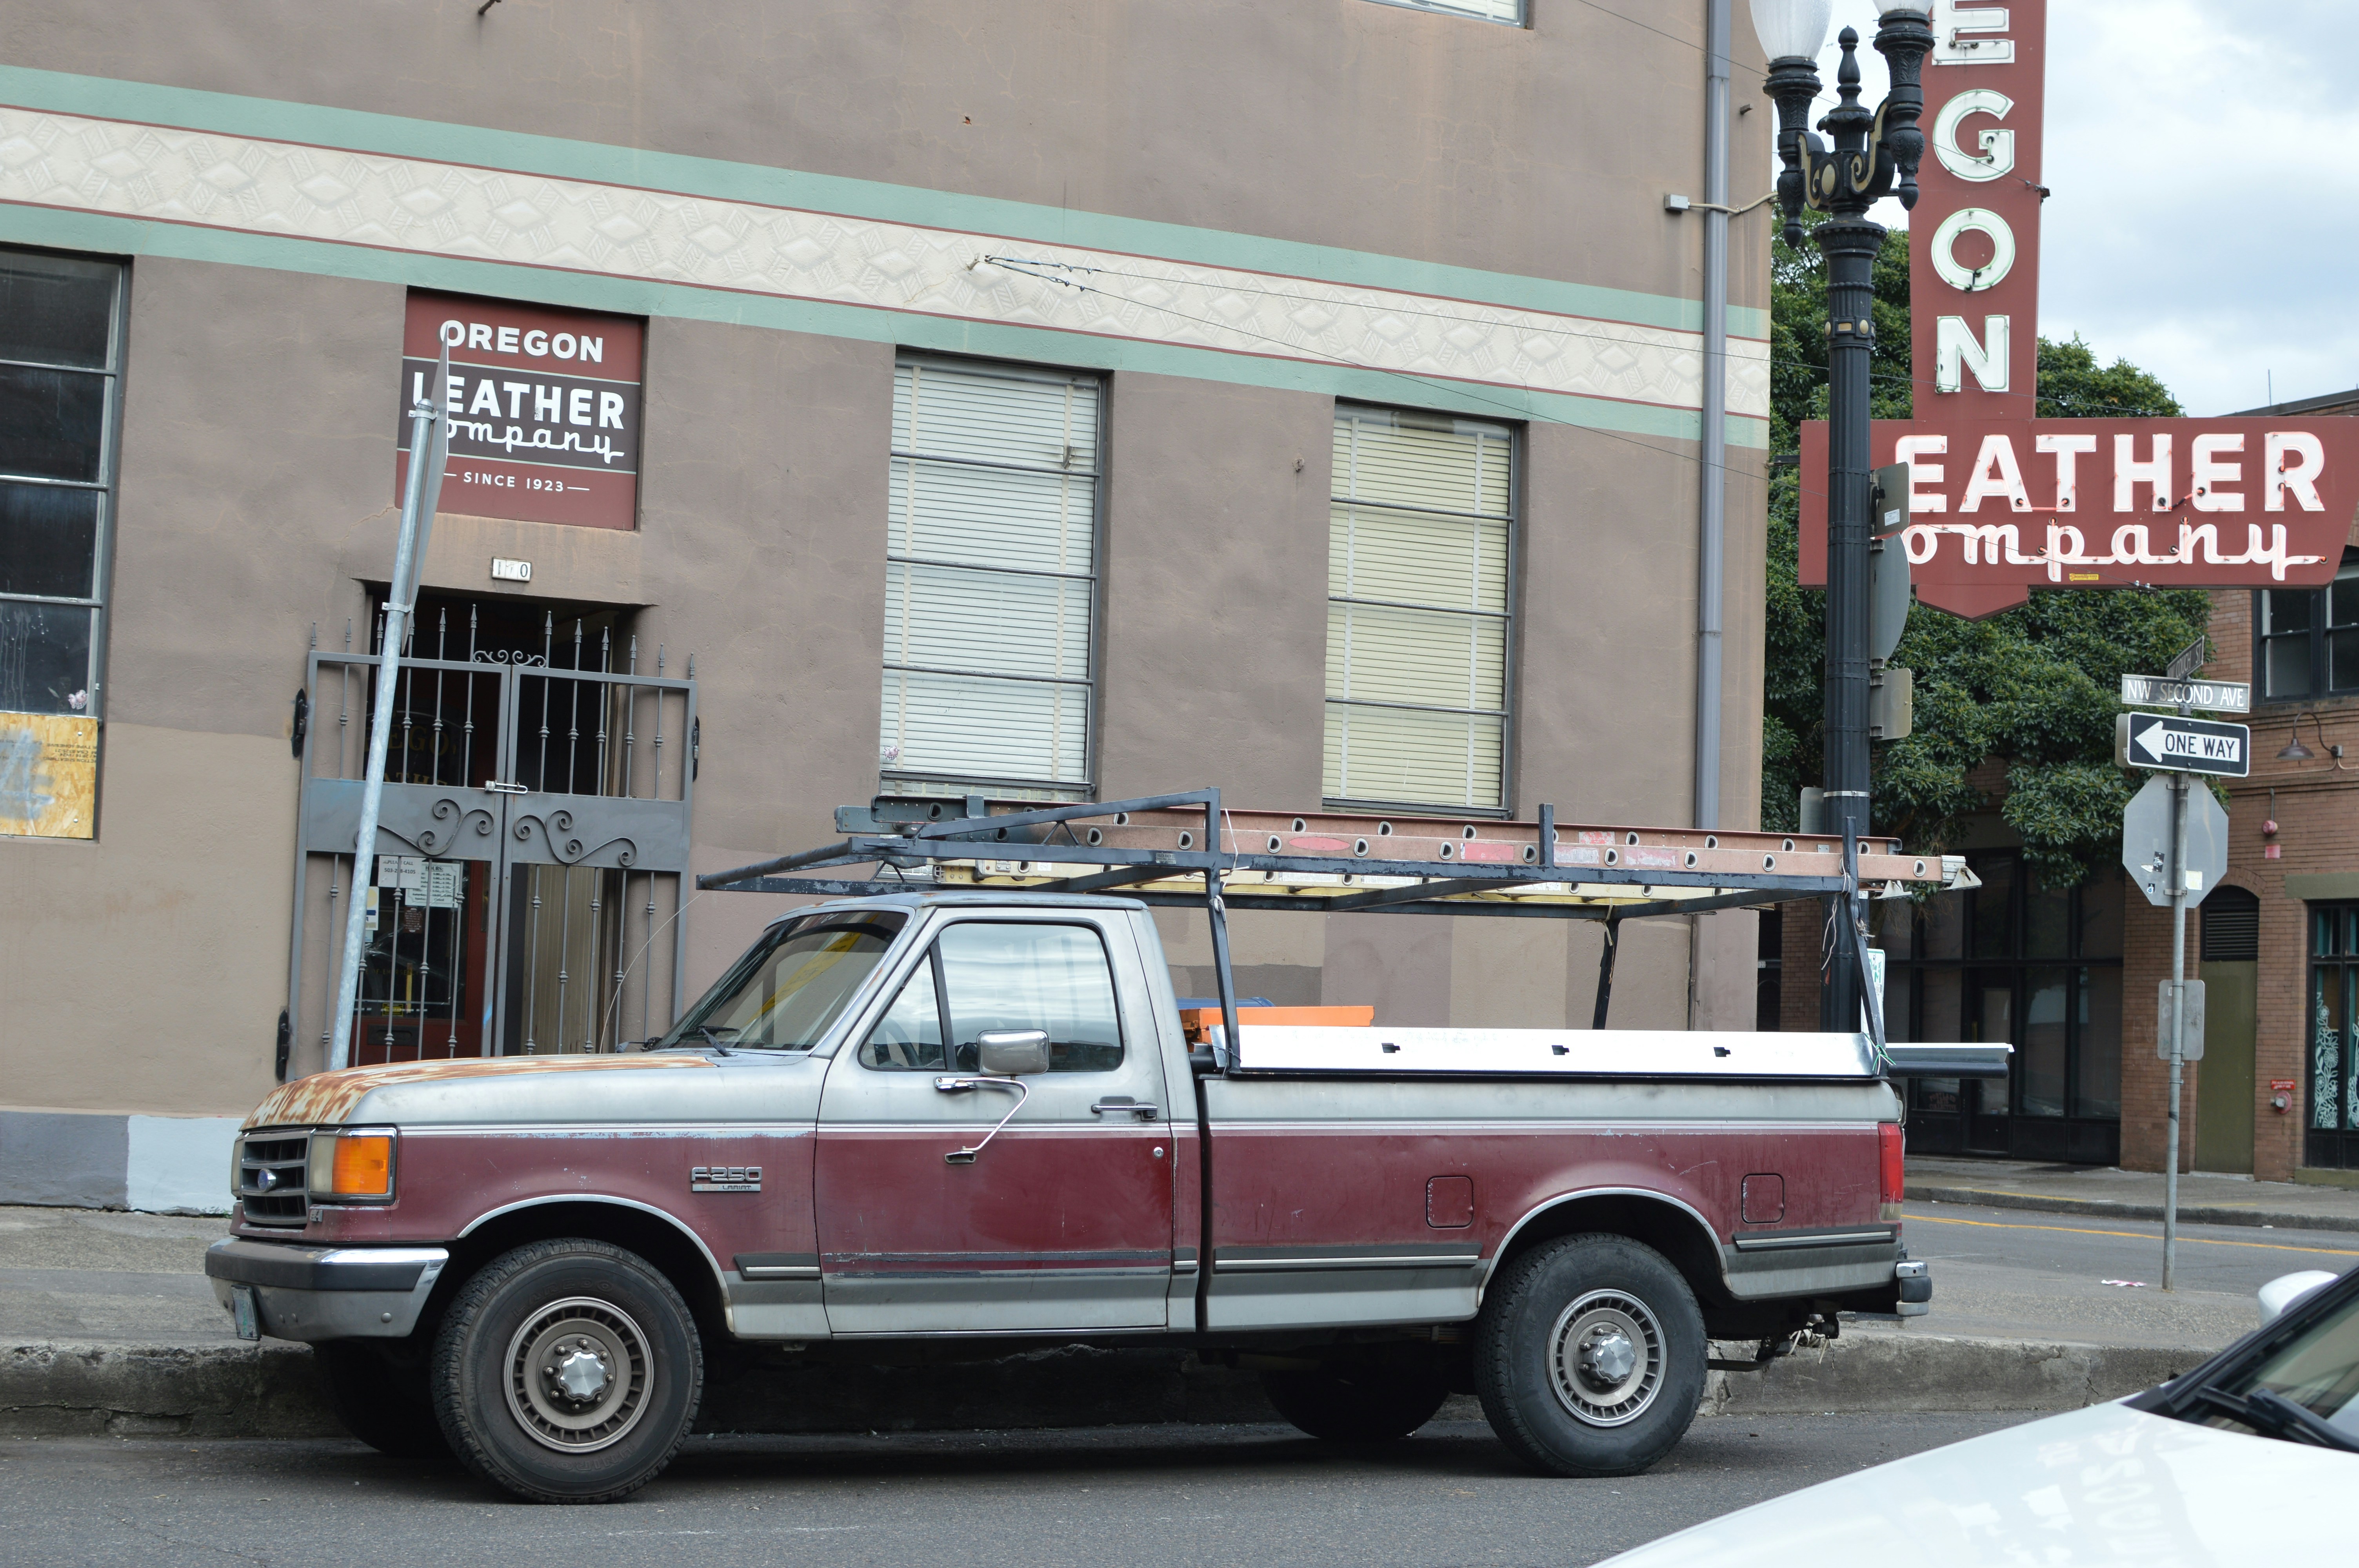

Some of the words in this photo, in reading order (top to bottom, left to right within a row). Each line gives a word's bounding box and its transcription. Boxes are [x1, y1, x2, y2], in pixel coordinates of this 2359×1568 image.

[440, 320, 603, 363] OREGON
[448, 419, 625, 464] ompany
[463, 472, 515, 488] SINCE
[526, 477, 564, 492] 1923
[1895, 431, 2325, 512] EATHER
[1901, 519, 2325, 582] ompany
[2176, 651, 2191, 678] COUCH
[2195, 643, 2202, 664] ST
[2127, 680, 2152, 700] NW
[2160, 683, 2213, 705] SECOND
[2220, 688, 2244, 707] AVE
[2165, 733, 2196, 755] ONE
[2203, 737, 2235, 759] WAY
[691, 1167, 762, 1183] F-250
[513, 1277, 614, 1318] LAREDO
[514, 1436, 636, 1472] UNIROYAL
